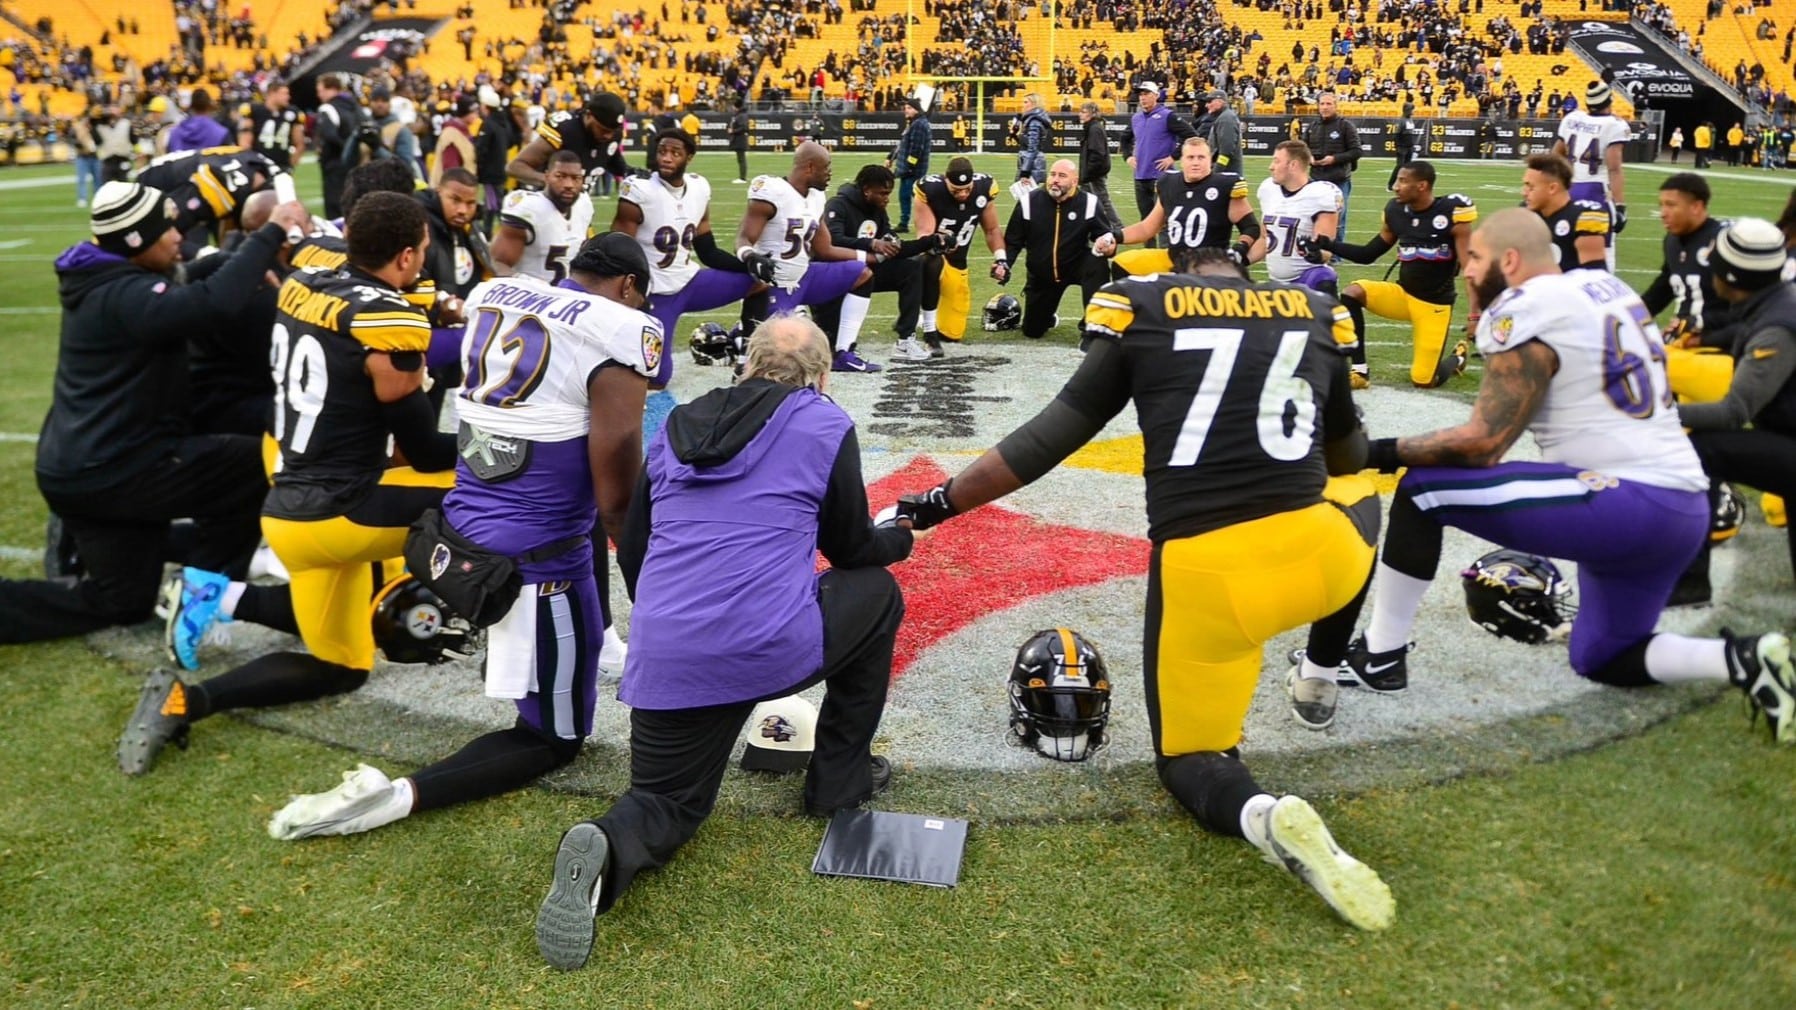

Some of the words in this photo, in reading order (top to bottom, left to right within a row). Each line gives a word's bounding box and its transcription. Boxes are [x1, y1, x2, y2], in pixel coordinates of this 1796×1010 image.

[259, 119, 290, 149] 44
[1051, 119, 1064, 130] 42
[1431, 125, 1445, 136] 23
[1519, 127, 1532, 137] 83
[1052, 136, 1064, 147] 31
[1430, 141, 1444, 152] 62
[937, 214, 978, 246] 56
[1167, 206, 1208, 248] 60
[1262, 214, 1301, 257] 57
[483, 283, 553, 315] BROWN
[547, 298, 592, 326] JR
[1163, 286, 1315, 320] OKORAFOR
[459, 306, 552, 409] 12
[1167, 327, 1318, 467] 76
